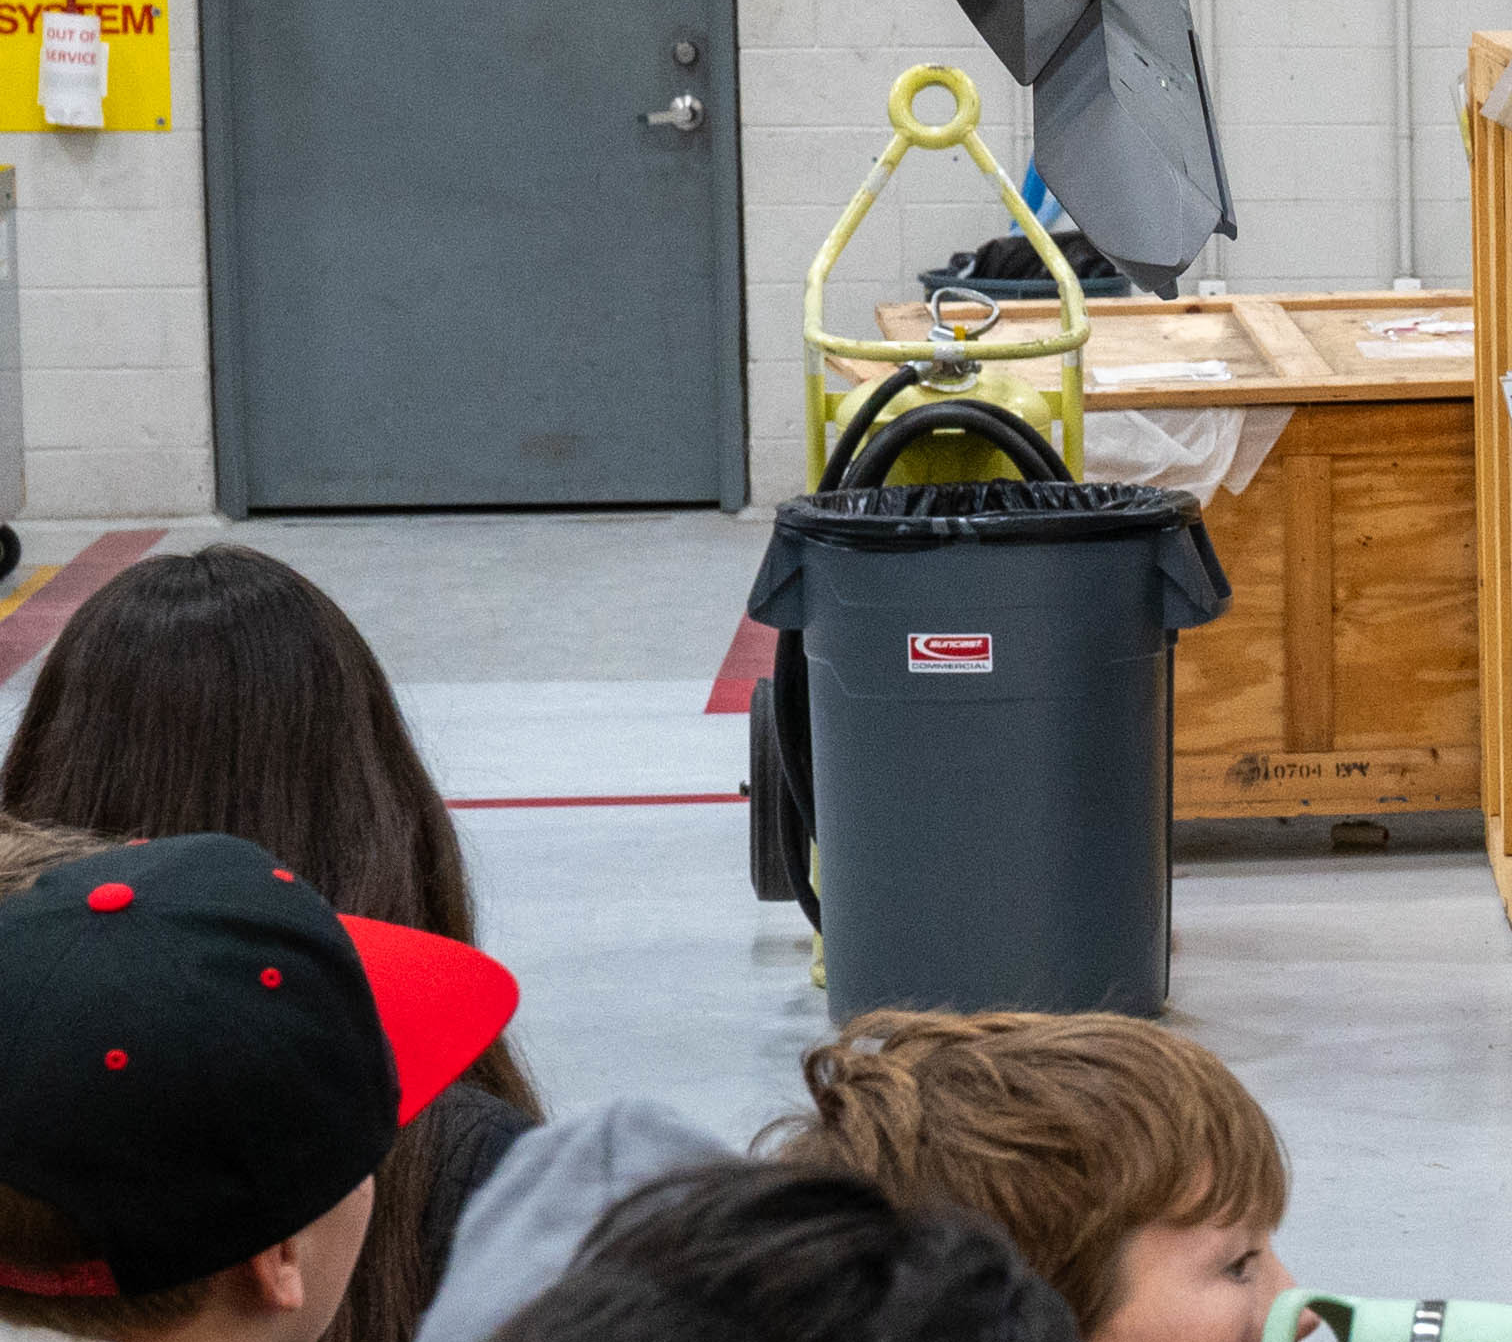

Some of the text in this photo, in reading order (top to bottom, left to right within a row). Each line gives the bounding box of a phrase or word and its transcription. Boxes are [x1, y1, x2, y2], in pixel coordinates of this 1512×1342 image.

[0, 4, 155, 35] SYEM
[46, 28, 97, 43] OUT OF
[45, 50, 97, 65] SERVICE
[912, 662, 989, 670] COMMERCIAL
